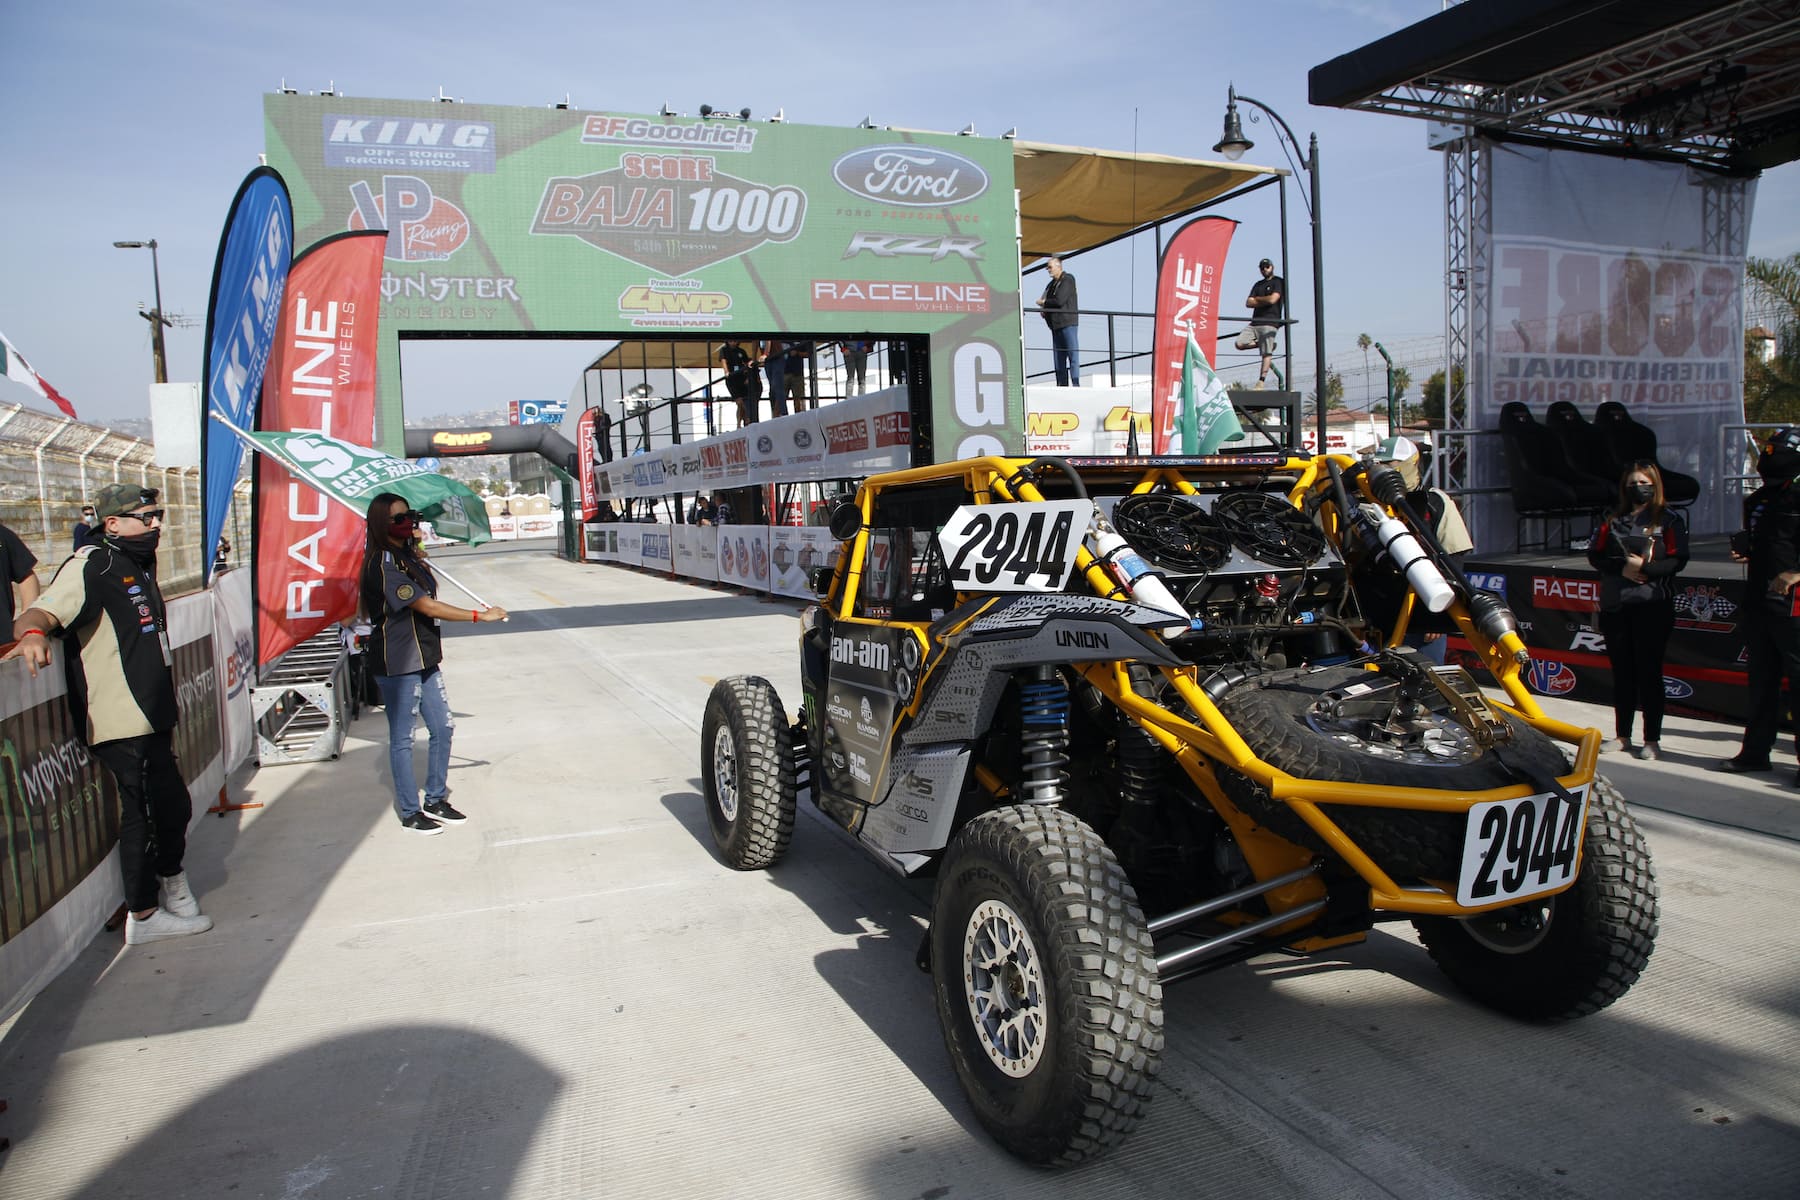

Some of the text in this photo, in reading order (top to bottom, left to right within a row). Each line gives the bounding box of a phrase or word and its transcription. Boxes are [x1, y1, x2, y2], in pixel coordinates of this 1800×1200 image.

[329, 119, 490, 148] KING
[584, 116, 755, 145] BFGoodrich
[623, 155, 713, 182] SCORE
[864, 152, 961, 198] Ford
[542, 184, 800, 233] BAJA 1000
[407, 222, 468, 250] Racing
[840, 230, 988, 264] RZR
[380, 272, 521, 302] ONSTER
[814, 282, 986, 303] RACELINE
[1199, 265, 1214, 331] WHEELS
[223, 211, 283, 416] KING
[915, 303, 987, 312] WHEELS
[337, 301, 356, 386] WHEELS
[286, 298, 338, 620] RACLINE
[951, 510, 1075, 588] 2944
[1010, 602, 1137, 619] BFGoodrich
[832, 636, 889, 672] an-am
[1055, 629, 1110, 649] UNION
[1471, 790, 1584, 899] 2944
